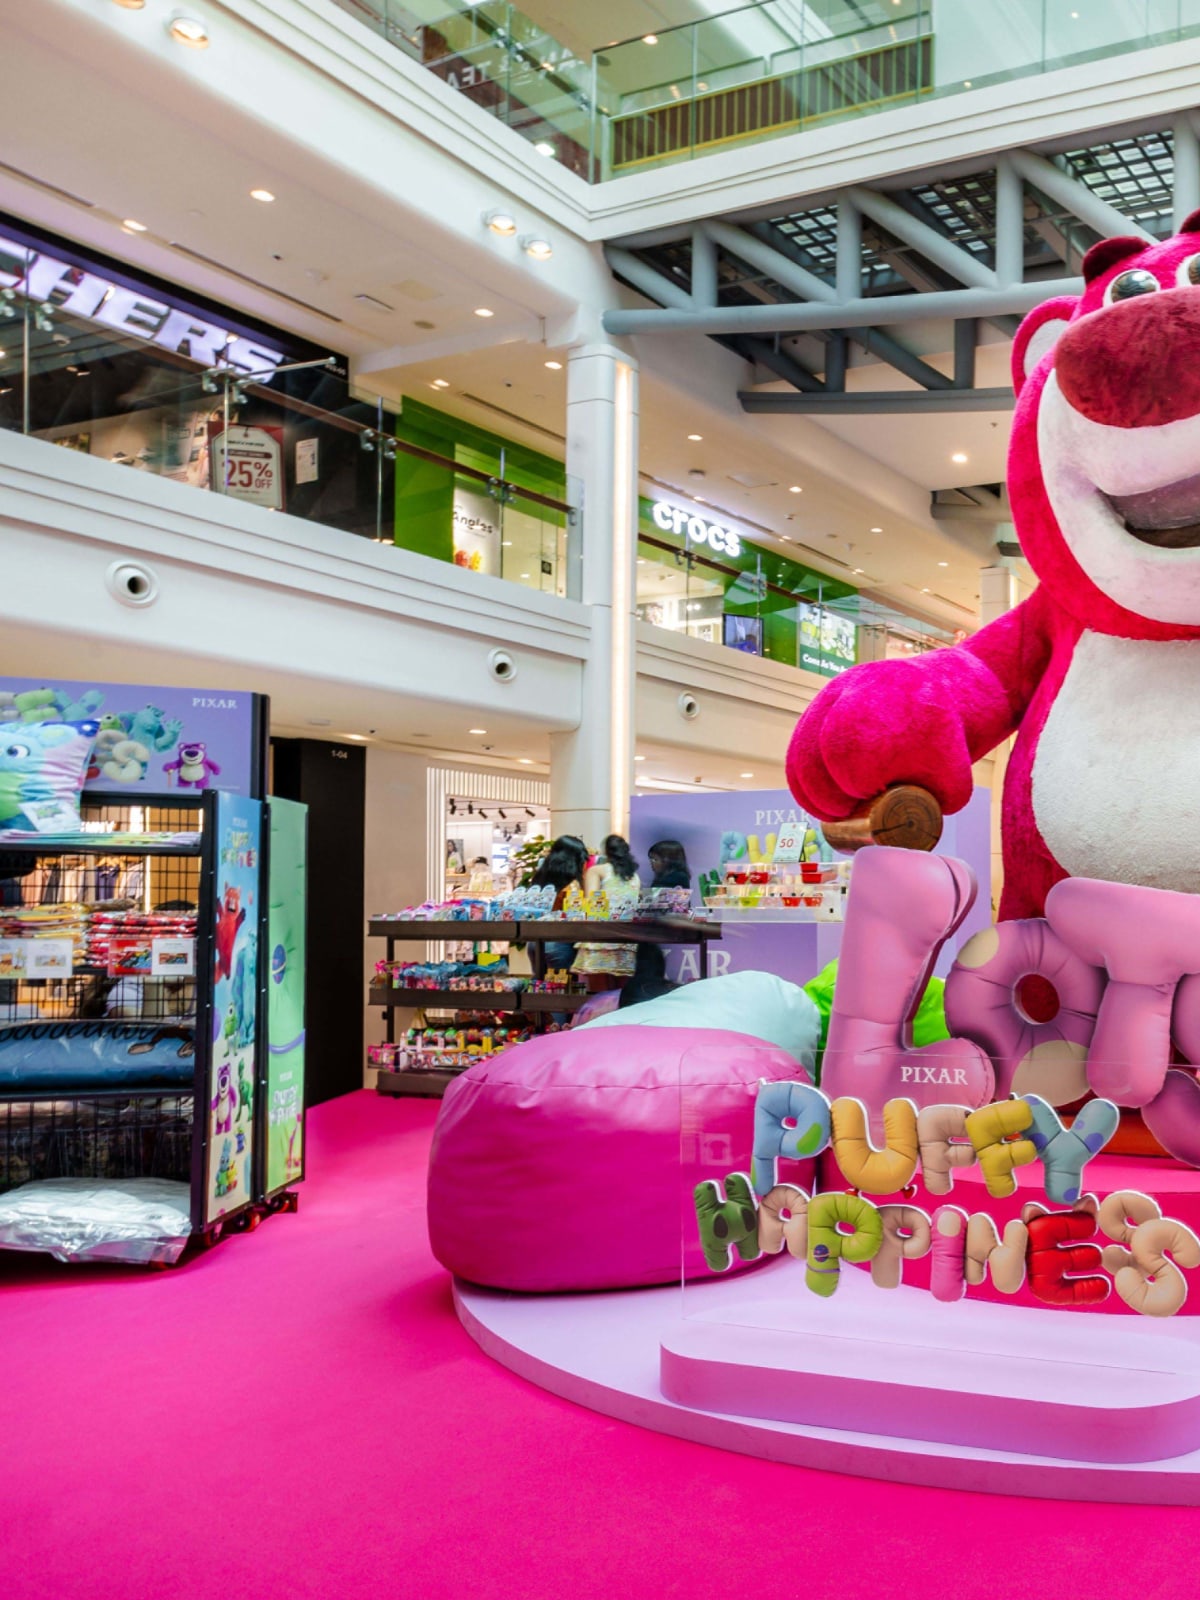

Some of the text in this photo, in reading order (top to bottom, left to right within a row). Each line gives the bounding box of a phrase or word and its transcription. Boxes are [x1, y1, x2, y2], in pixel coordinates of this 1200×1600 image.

[254, 478, 273, 489] OFF
[652, 501, 742, 558] crocs
[191, 697, 238, 710] PIXAR
[754, 810, 812, 827] PIXAR
[779, 837, 794, 849] 50
[900, 1066, 969, 1086] PIXAR
[750, 1077, 1120, 1207] PUFFY
